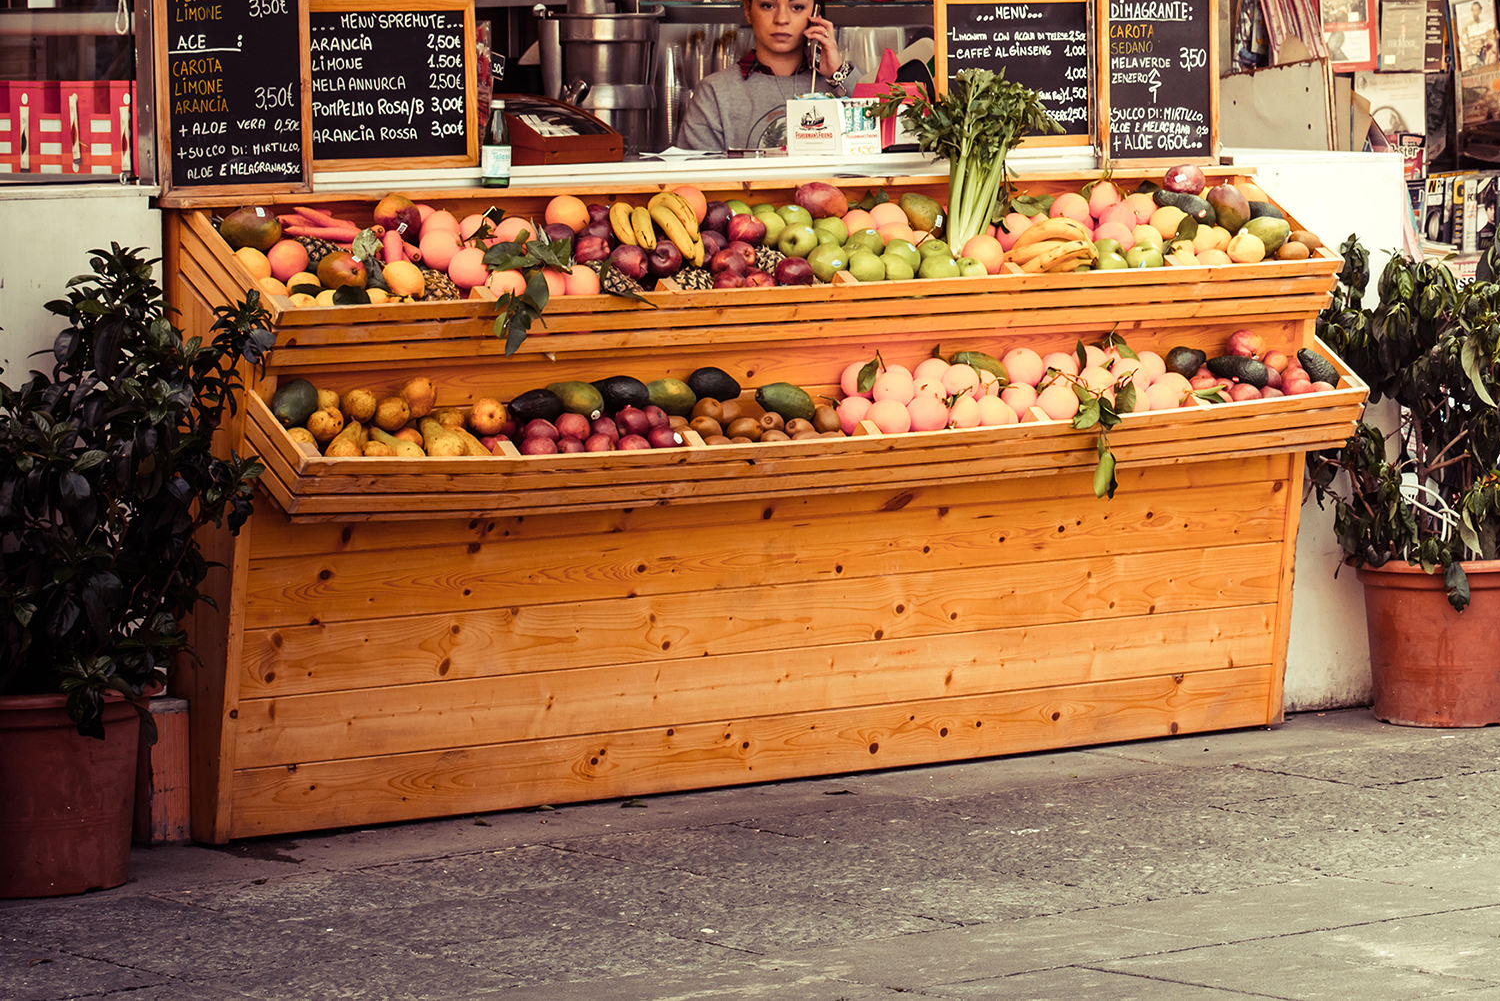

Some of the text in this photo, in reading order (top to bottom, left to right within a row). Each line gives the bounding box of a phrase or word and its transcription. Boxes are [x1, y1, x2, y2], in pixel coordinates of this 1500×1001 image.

[176, 3, 223, 22] LIMONE
[993, 32, 1010, 41] CON
[1110, 24, 1154, 39] CAROTA
[177, 34, 207, 49] ACE
[311, 34, 461, 51] ARANCIA 2,50€
[1110, 40, 1153, 55] SEDANO
[172, 57, 223, 77] CAROTA
[311, 55, 363, 71] LIMONE
[1111, 56, 1171, 69] MELA VERDE
[312, 77, 346, 92] MELA
[348, 76, 406, 91] ANNURCA
[1111, 72, 1149, 84] ZENZERO
[174, 77, 223, 96] LIMONE
[175, 82, 294, 114] ARANCIA 3,50€
[312, 99, 374, 117] POMPELMO
[192, 122, 228, 136] ALOE
[237, 118, 266, 130] VERA
[313, 124, 375, 143] ARANCIA
[380, 127, 418, 140] ROSSA
[1125, 133, 1154, 150] ALOE
[187, 166, 214, 180] ALOE
